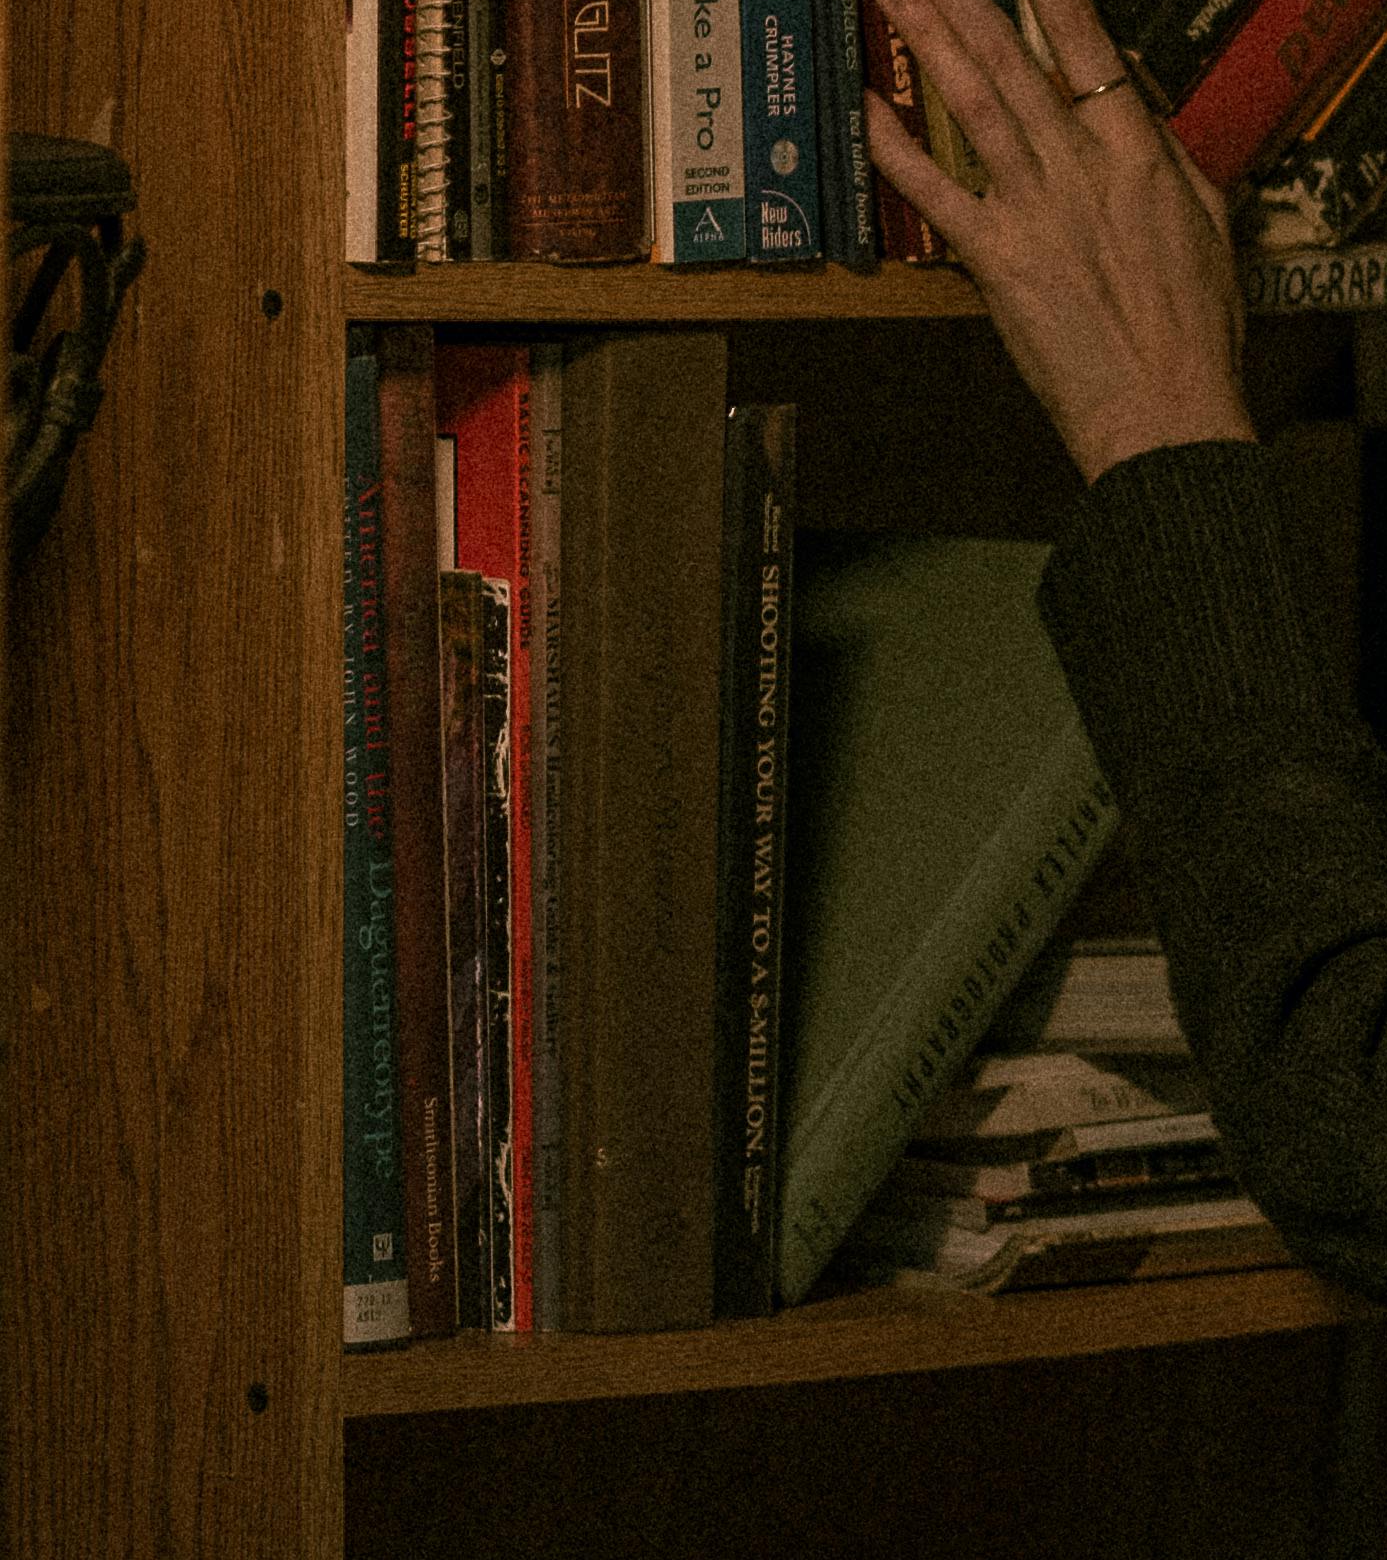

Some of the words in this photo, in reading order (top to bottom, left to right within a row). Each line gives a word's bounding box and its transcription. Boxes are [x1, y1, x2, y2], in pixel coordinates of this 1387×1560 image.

[694, 52, 713, 71] a
[764, 14, 781, 118] CRUMPLER
[780, 34, 798, 117] HAYNES
[695, 86, 721, 151] Pro
[848, 109, 862, 137] tea
[684, 165, 730, 180] SECOND
[685, 181, 731, 196] EDITION
[850, 142, 867, 186] table
[760, 202, 789, 224] New
[761, 226, 802, 251] Riders
[855, 191, 872, 246] books
[518, 393, 531, 455] BASIC
[518, 463, 531, 577] SCANNING
[357, 475, 382, 654] America
[519, 586, 532, 650] GUIDE
[758, 564, 780, 727] SHOOTING
[344, 655, 357, 728] JOHN
[362, 671, 385, 751] and
[345, 745, 360, 829] WOOD
[365, 772, 388, 841] the
[756, 738, 777, 824] YOUR
[754, 831, 775, 898] WAY
[753, 905, 773, 952] TO
[752, 960, 771, 985] A
[358, 859, 396, 1180] Daguerreotype
[893, 901, 1032, 1118] PHOTOGRAPHY
[423, 1095, 441, 1217] Smithsonian
[428, 1220, 443, 1284] Books
